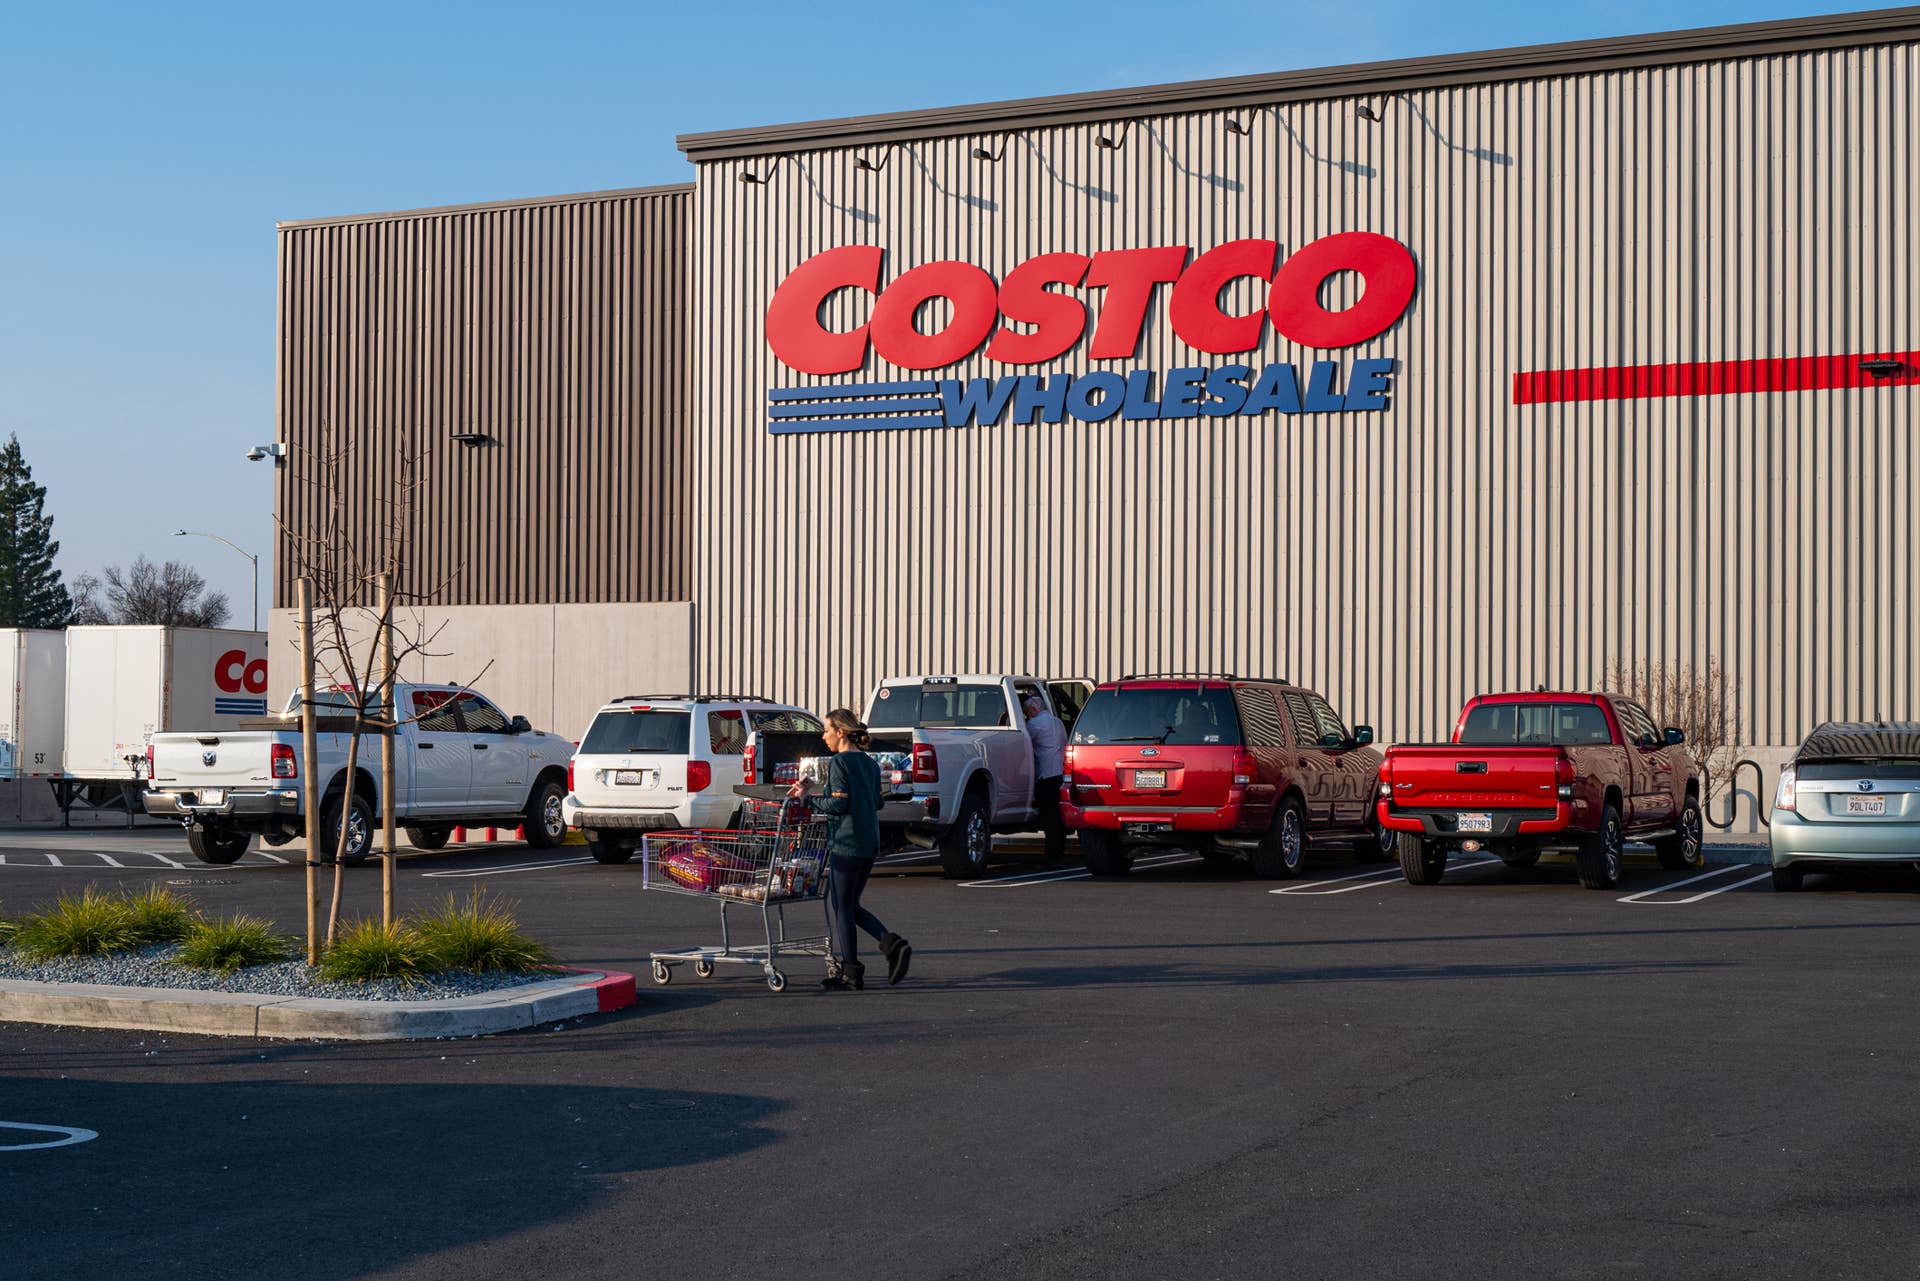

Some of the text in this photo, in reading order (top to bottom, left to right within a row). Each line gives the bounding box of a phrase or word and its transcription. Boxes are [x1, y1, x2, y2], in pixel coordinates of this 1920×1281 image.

[766, 231, 1416, 375] COSTCO
[939, 358, 1393, 428] WHOLESALE
[1459, 819, 1491, 829] 95079R3
